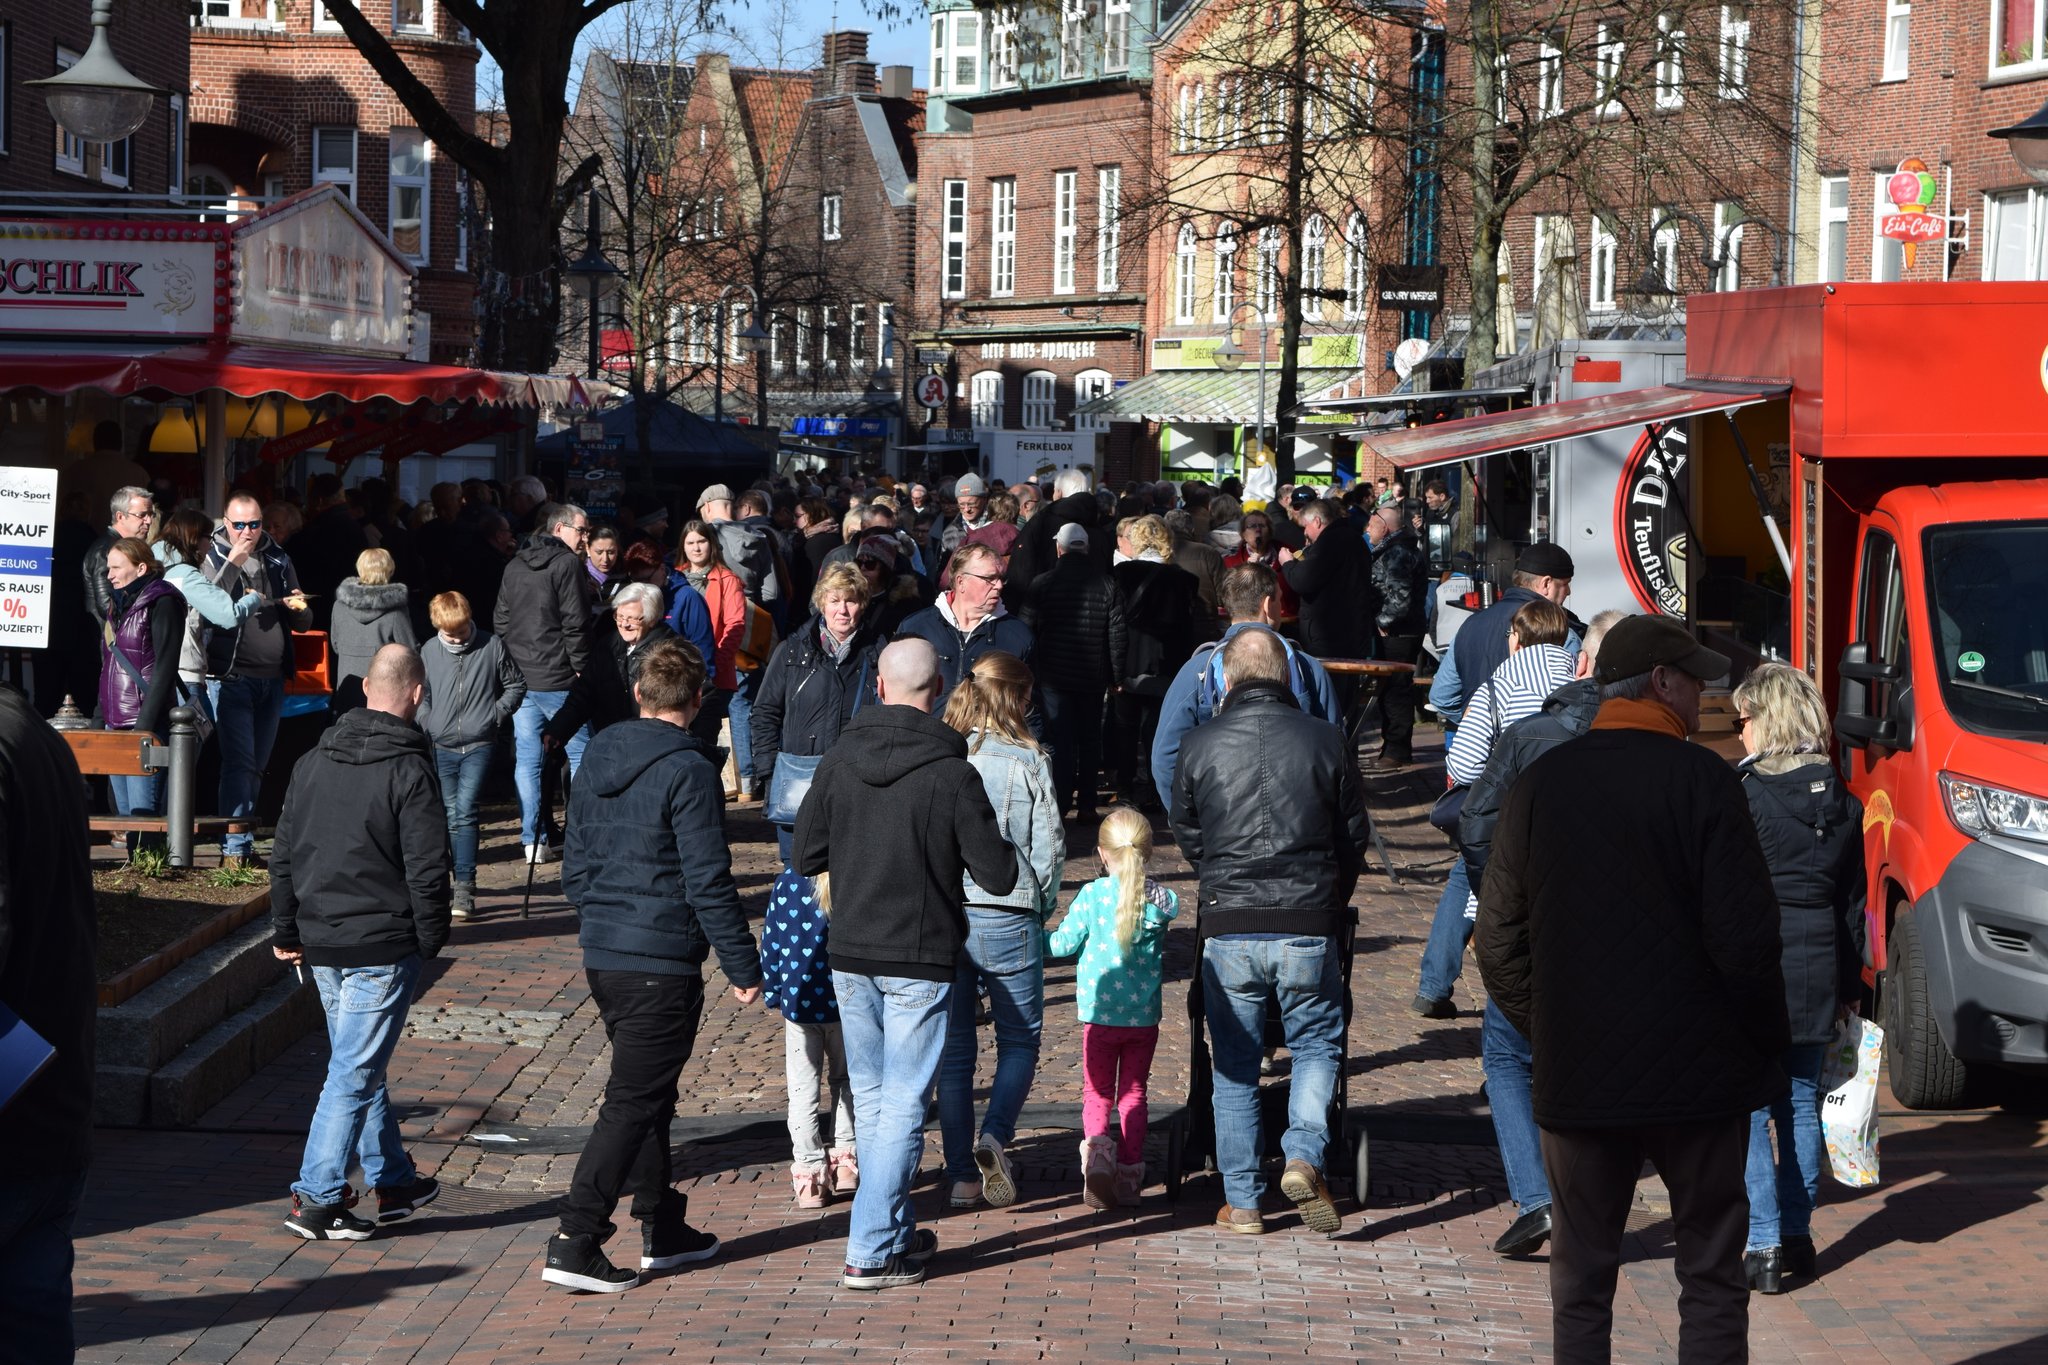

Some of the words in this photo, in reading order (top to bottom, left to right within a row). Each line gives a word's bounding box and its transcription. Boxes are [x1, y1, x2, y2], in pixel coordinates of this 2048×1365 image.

[1885, 216, 1941, 236] Eis-Café
[1017, 441, 1072, 451] FERKELBOX
[1, 489, 51, 500] City-Sport
[1634, 516, 1683, 613] Teuflisch
[9, 583, 44, 594] RAUS!
[1968, 653, 1975, 661] 4
